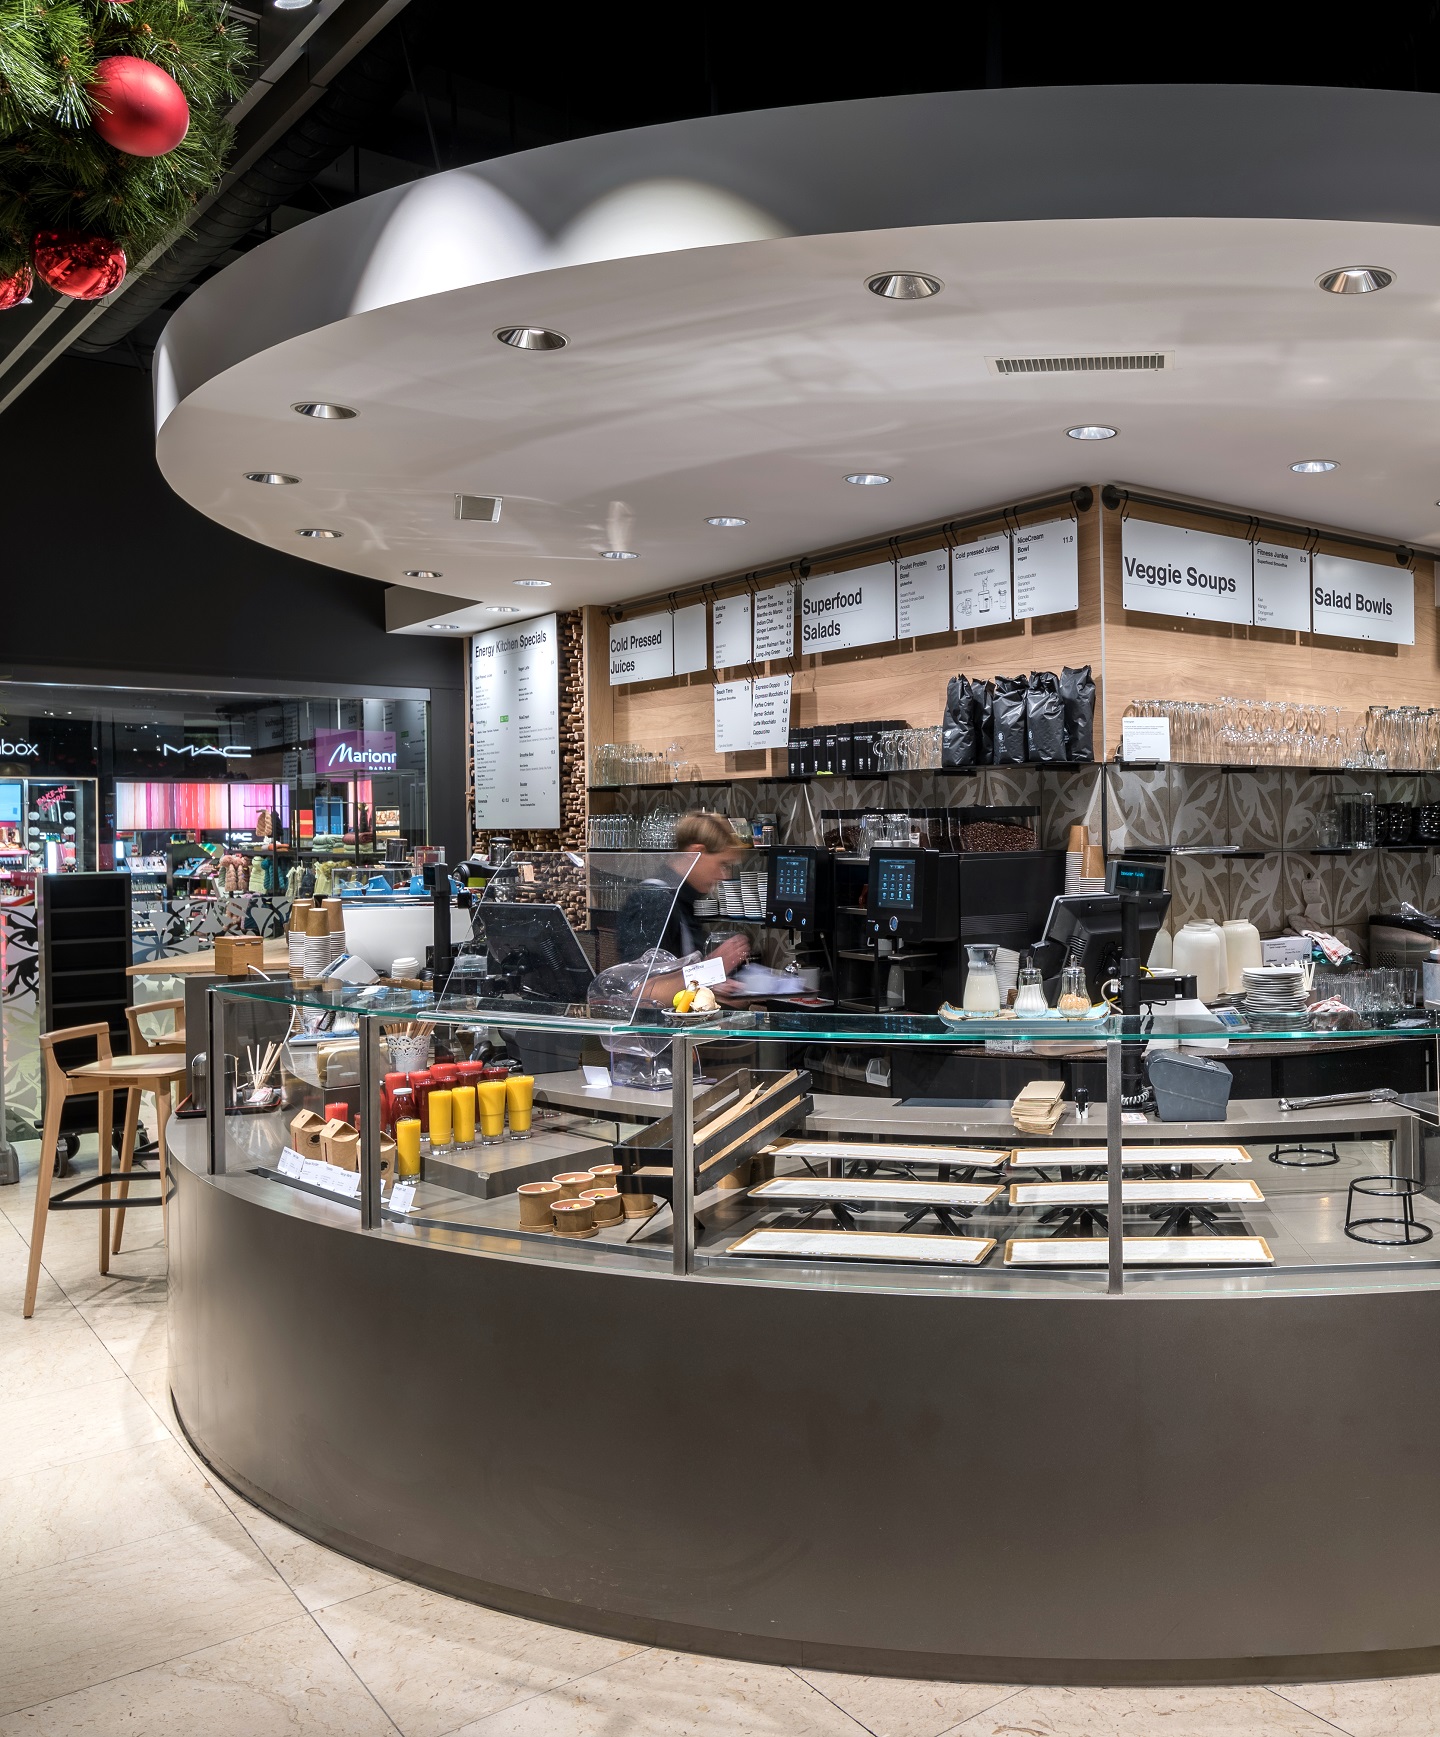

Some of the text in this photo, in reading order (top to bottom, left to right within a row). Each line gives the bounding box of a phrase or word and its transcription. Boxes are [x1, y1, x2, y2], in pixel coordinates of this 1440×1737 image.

[1017, 533, 1044, 544] NiceCream
[967, 548, 984, 558] pressed
[985, 544, 999, 553] Juices
[1018, 545, 1029, 553] Bowl
[1257, 549, 1273, 558] Fitness
[1274, 552, 1288, 560] Junkie
[913, 560, 927, 568] Protein
[1124, 556, 1236, 594] Veggie Soups
[803, 587, 862, 615] Superfood
[1315, 587, 1392, 615] Salad Bowls
[804, 620, 841, 641] Salads
[476, 630, 546, 658] Energy Kitchen Specials
[611, 630, 662, 652] Cold Pressed
[611, 660, 635, 674] Juices
